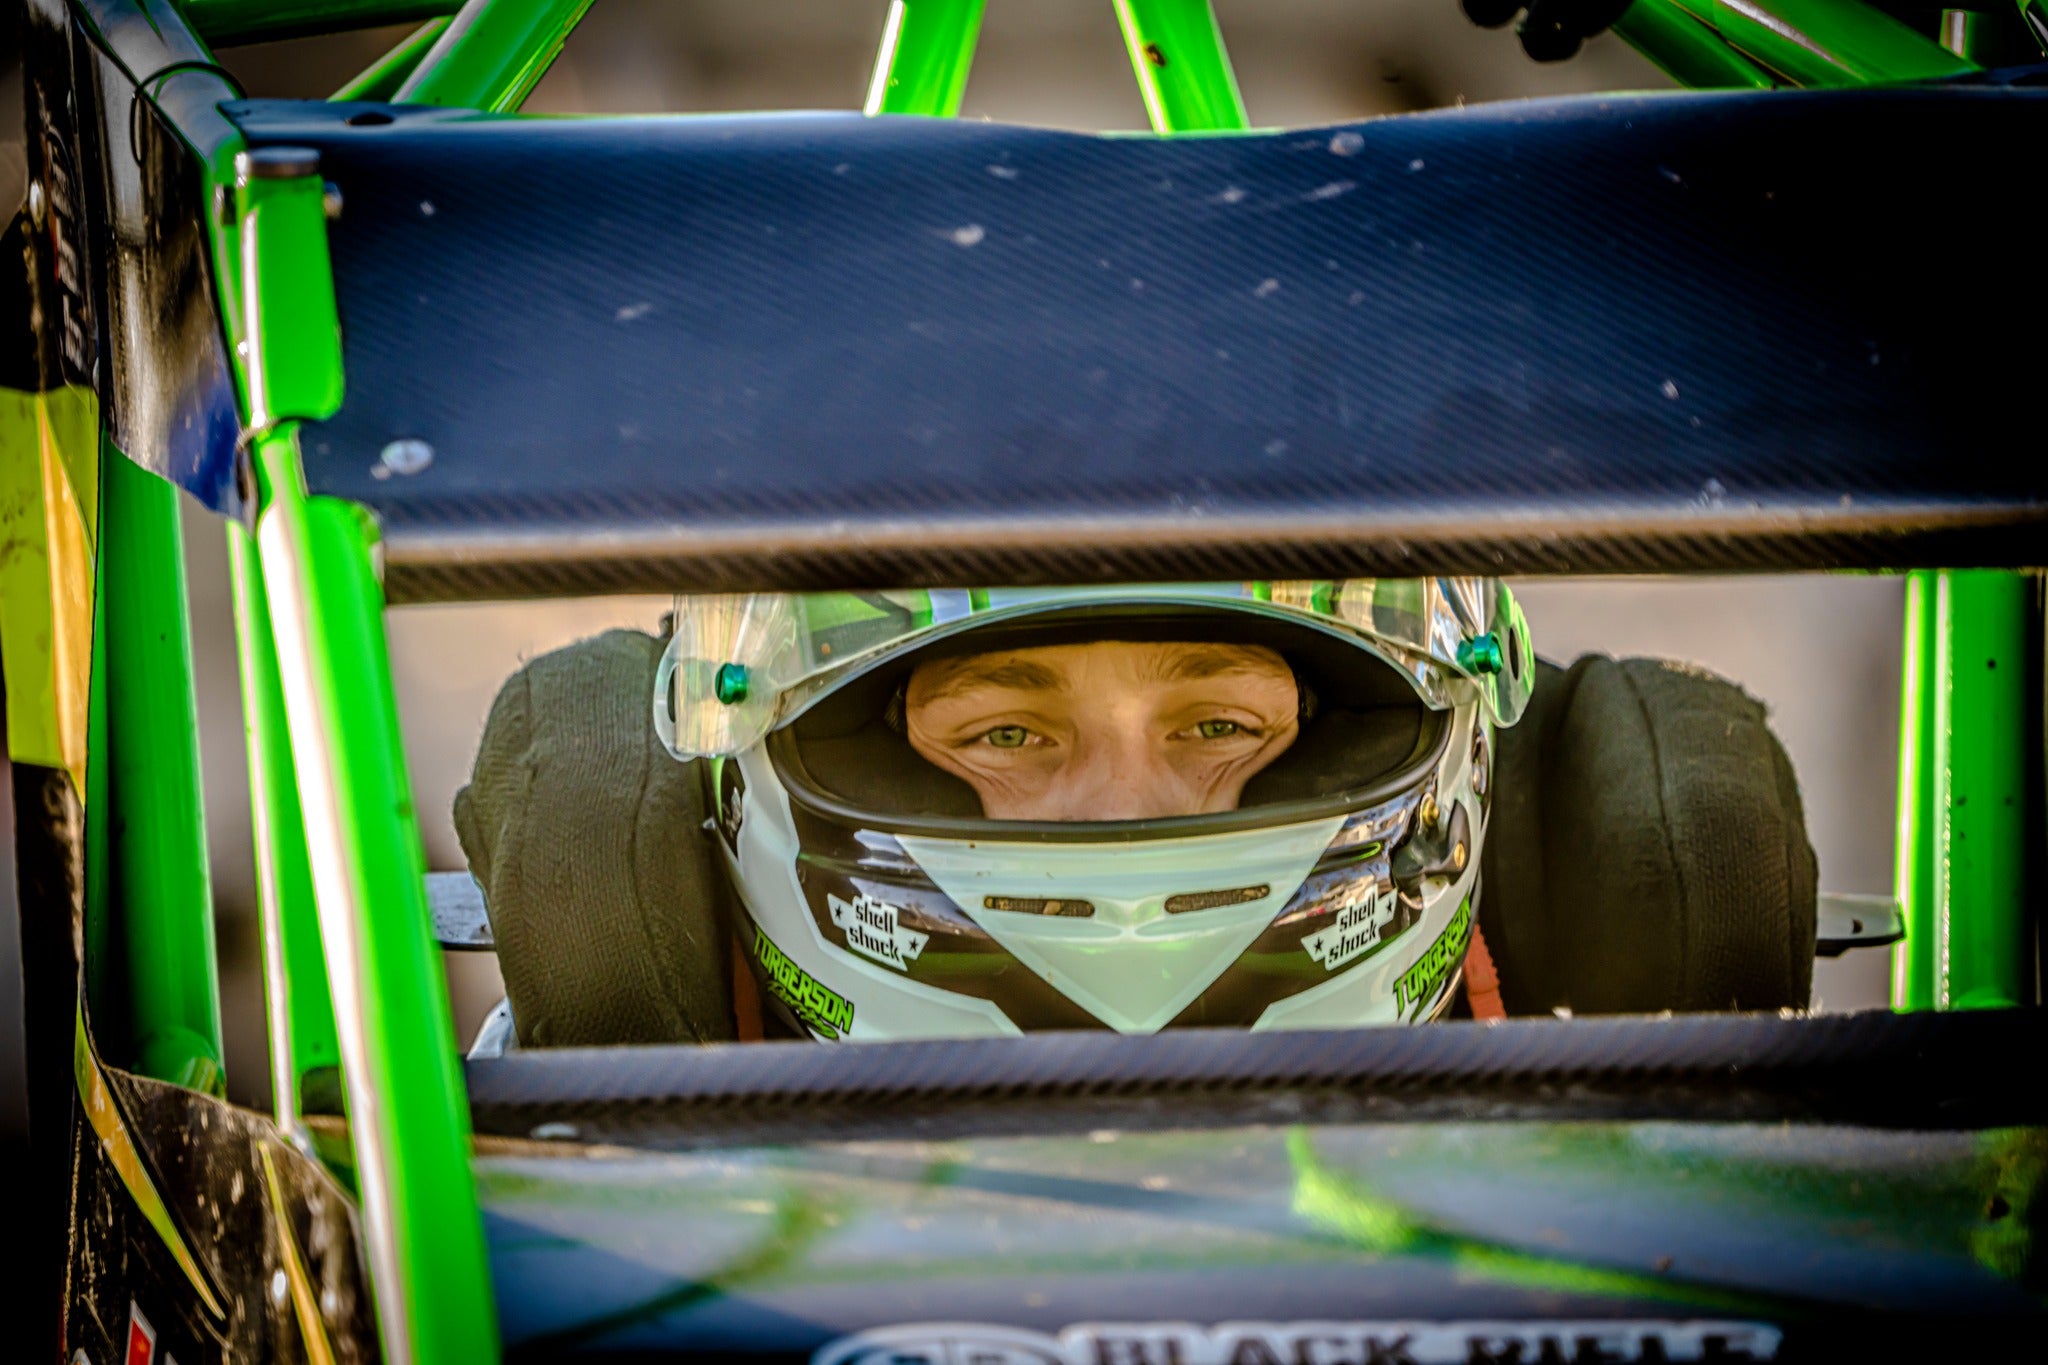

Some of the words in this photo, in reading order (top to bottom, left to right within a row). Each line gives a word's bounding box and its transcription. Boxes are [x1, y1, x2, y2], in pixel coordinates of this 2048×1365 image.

[855, 901, 894, 935] shell
[1339, 892, 1376, 933] shell
[849, 926, 900, 962] shock
[1328, 920, 1377, 964] shock
[1393, 891, 1472, 1020] TORGERSON
[754, 923, 855, 1035] TORGERSON
